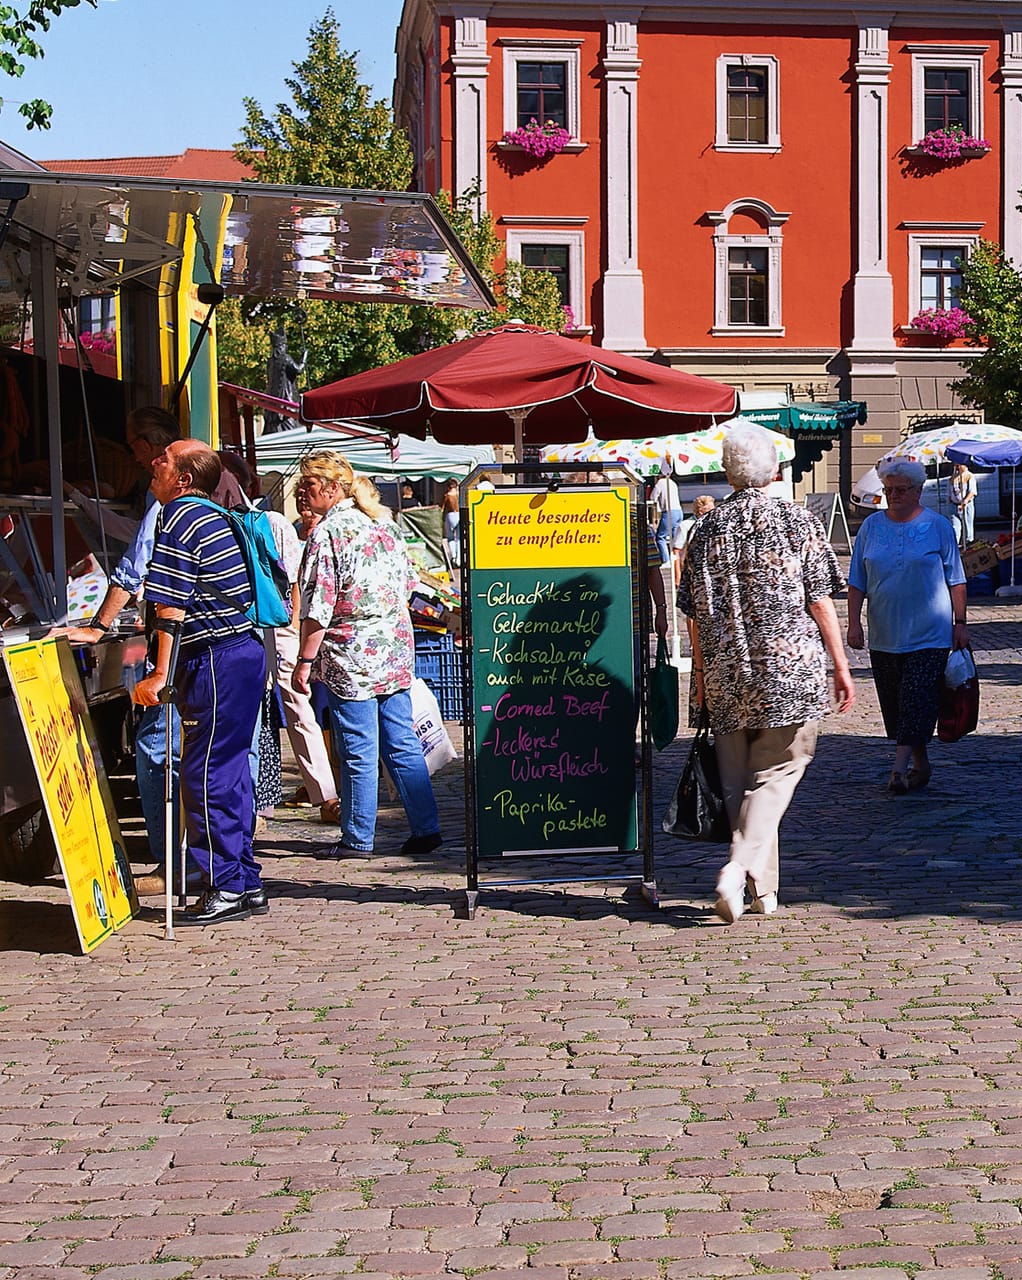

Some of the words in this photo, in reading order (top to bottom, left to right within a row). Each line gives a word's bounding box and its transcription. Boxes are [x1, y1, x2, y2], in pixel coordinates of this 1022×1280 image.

[487, 510, 531, 525] Heute
[536, 508, 611, 524] besonders
[496, 535, 513, 546] zu
[518, 529, 602, 549] empfehlen:
[487, 668, 525, 686] auch
[531, 666, 558, 686] mit
[562, 691, 611, 723] Beef
[543, 807, 608, 841] pastete
